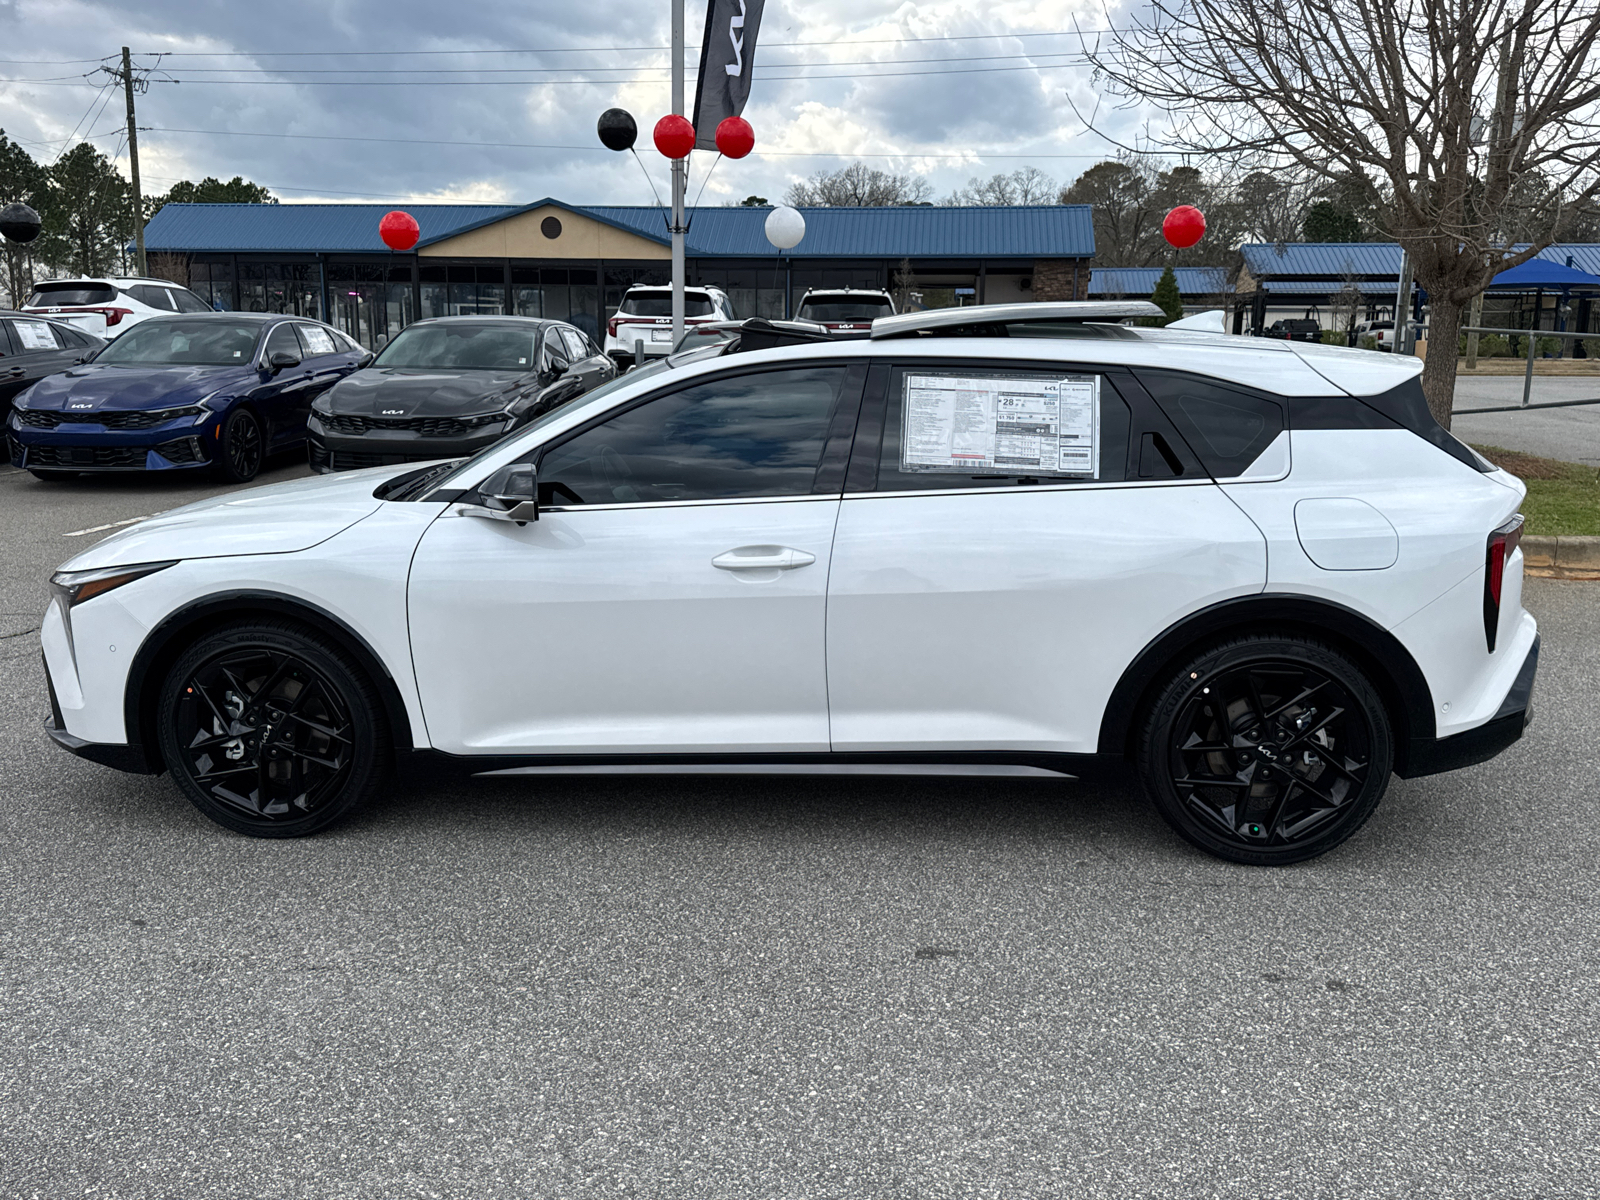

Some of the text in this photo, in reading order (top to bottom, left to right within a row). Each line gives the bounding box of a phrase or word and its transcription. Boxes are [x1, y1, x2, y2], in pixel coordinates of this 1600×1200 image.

[1003, 398, 1014, 406] 28
[261, 725, 272, 743] KIA
[1258, 746, 1277, 760] KIA
[173, 767, 212, 813] KUMHO
